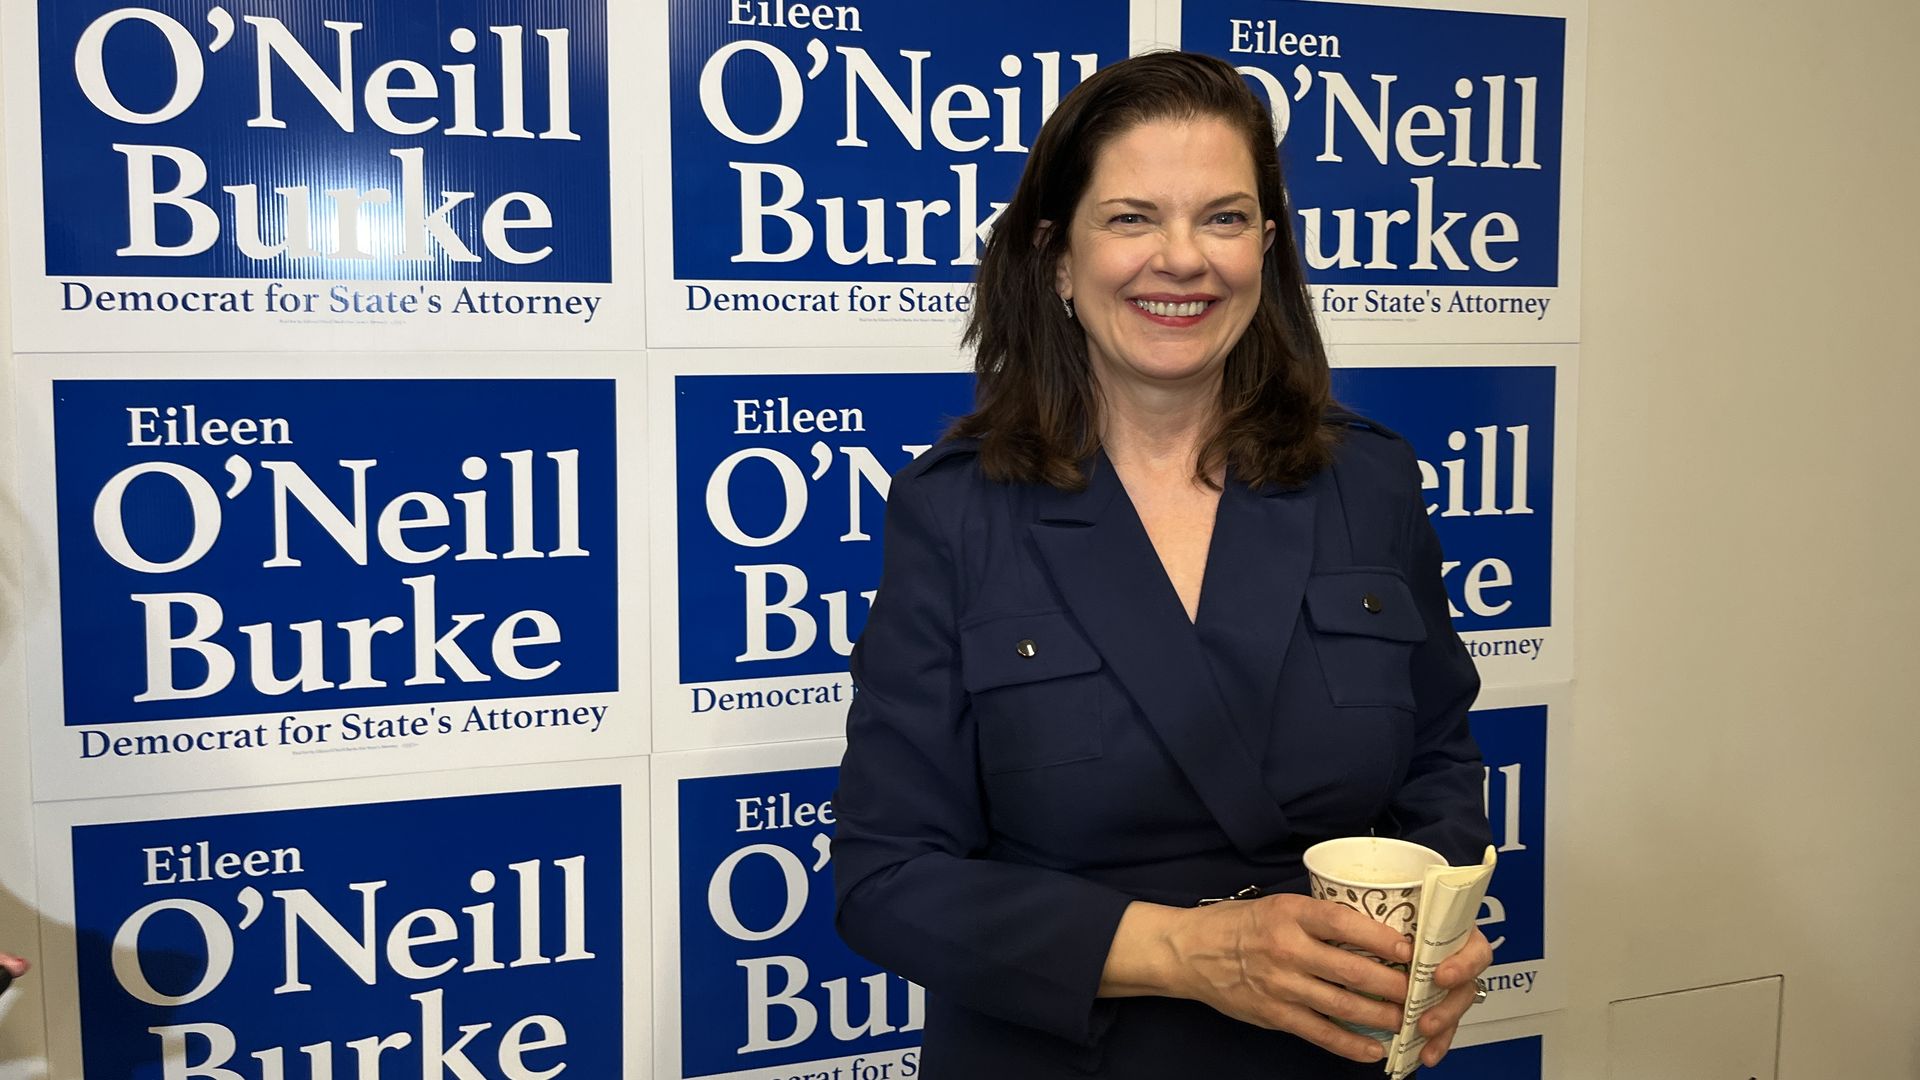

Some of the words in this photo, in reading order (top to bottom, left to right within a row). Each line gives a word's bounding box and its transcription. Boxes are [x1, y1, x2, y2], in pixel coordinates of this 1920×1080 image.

[728, 0, 862, 31] Eileen
[1230, 20, 1340, 57] Eileen
[75, 6, 581, 140] O'Neill
[112, 144, 553, 264] Burke
[1298, 176, 1519, 272] urke
[61, 282, 254, 312] Democrat
[266, 282, 318, 313] for
[331, 286, 441, 313] State's
[452, 288, 601, 323] Attorney
[686, 286, 839, 311] Democrat
[849, 286, 891, 311] for
[1323, 288, 1358, 312] for
[1366, 290, 1440, 312] State's
[1447, 291, 1550, 320] Attorney
[127, 405, 293, 446] Eileen
[734, 397, 865, 433] Eileen
[94, 449, 590, 574] O'Neill
[131, 575, 562, 703] Burke
[690, 682, 843, 714] Democrat
[79, 728, 267, 759] Democrat
[278, 715, 331, 746] for
[341, 707, 452, 741] State's
[460, 704, 608, 733] Attorney
[143, 841, 304, 885] Eileen
[112, 855, 595, 1006] O'Neill
[148, 988, 567, 1080] Burke
[850, 1058, 893, 1080] for
